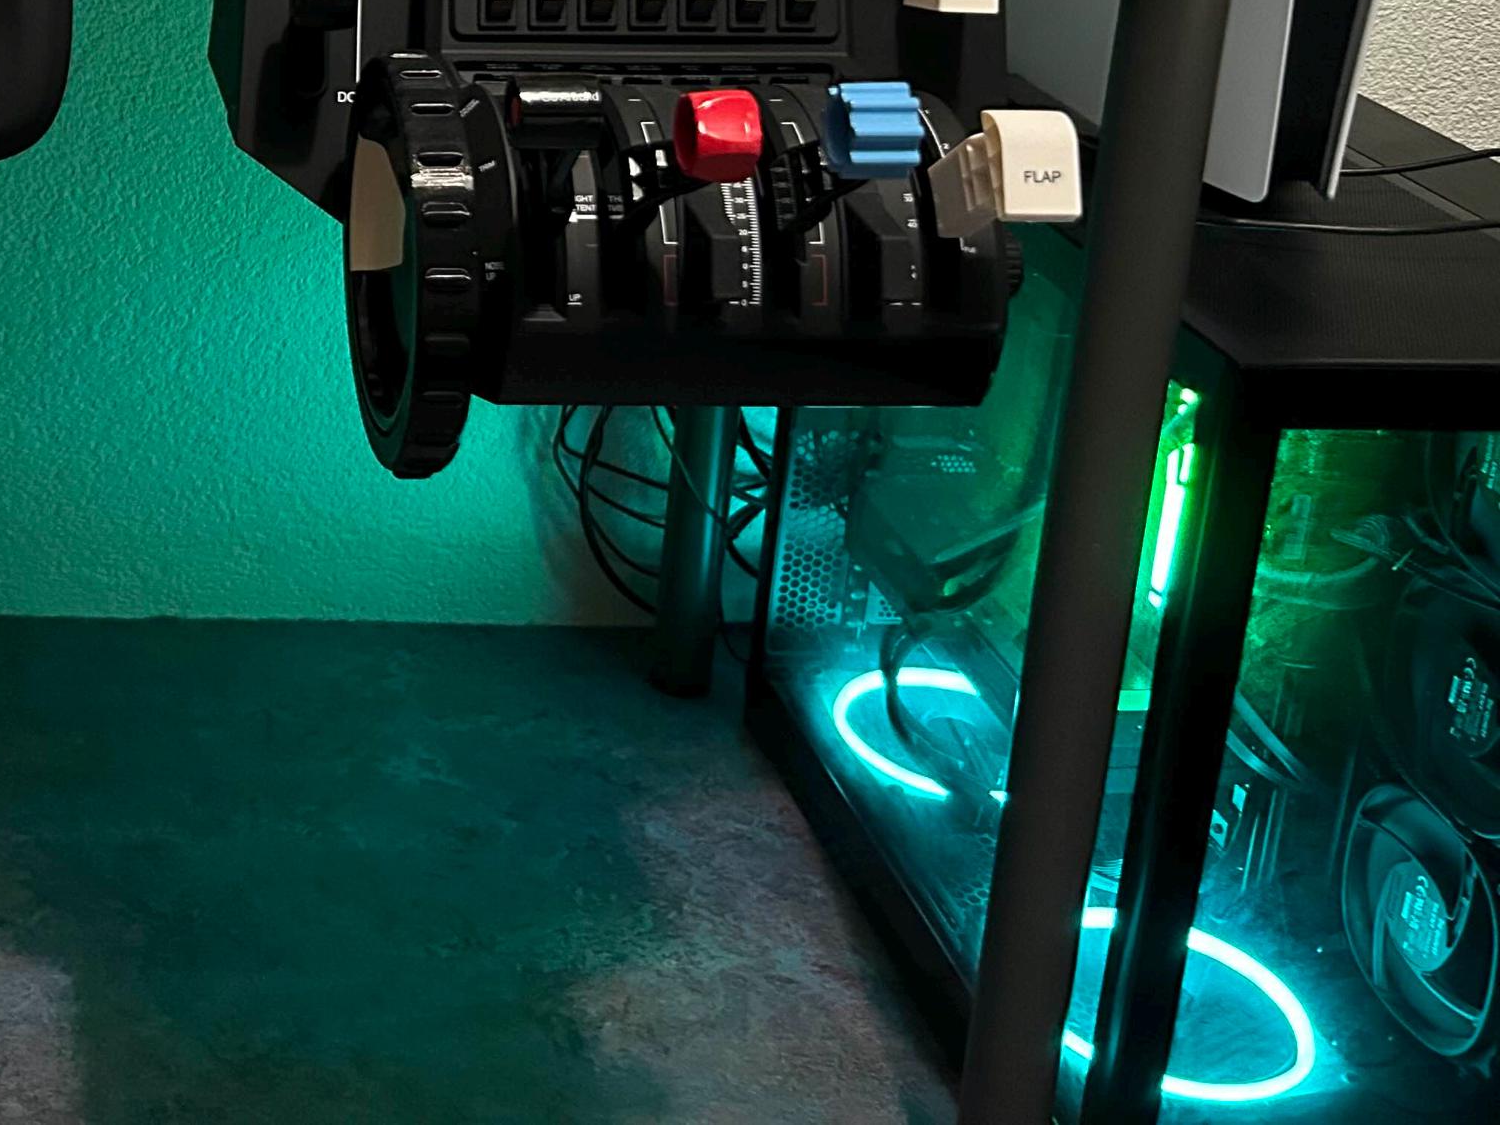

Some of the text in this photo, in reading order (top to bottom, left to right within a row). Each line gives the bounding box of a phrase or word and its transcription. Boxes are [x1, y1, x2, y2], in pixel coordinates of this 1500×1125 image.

[1023, 170, 1062, 184] FLAP
[575, 204, 597, 212] TENT
[738, 228, 749, 236] 20
[568, 293, 582, 303] UP
